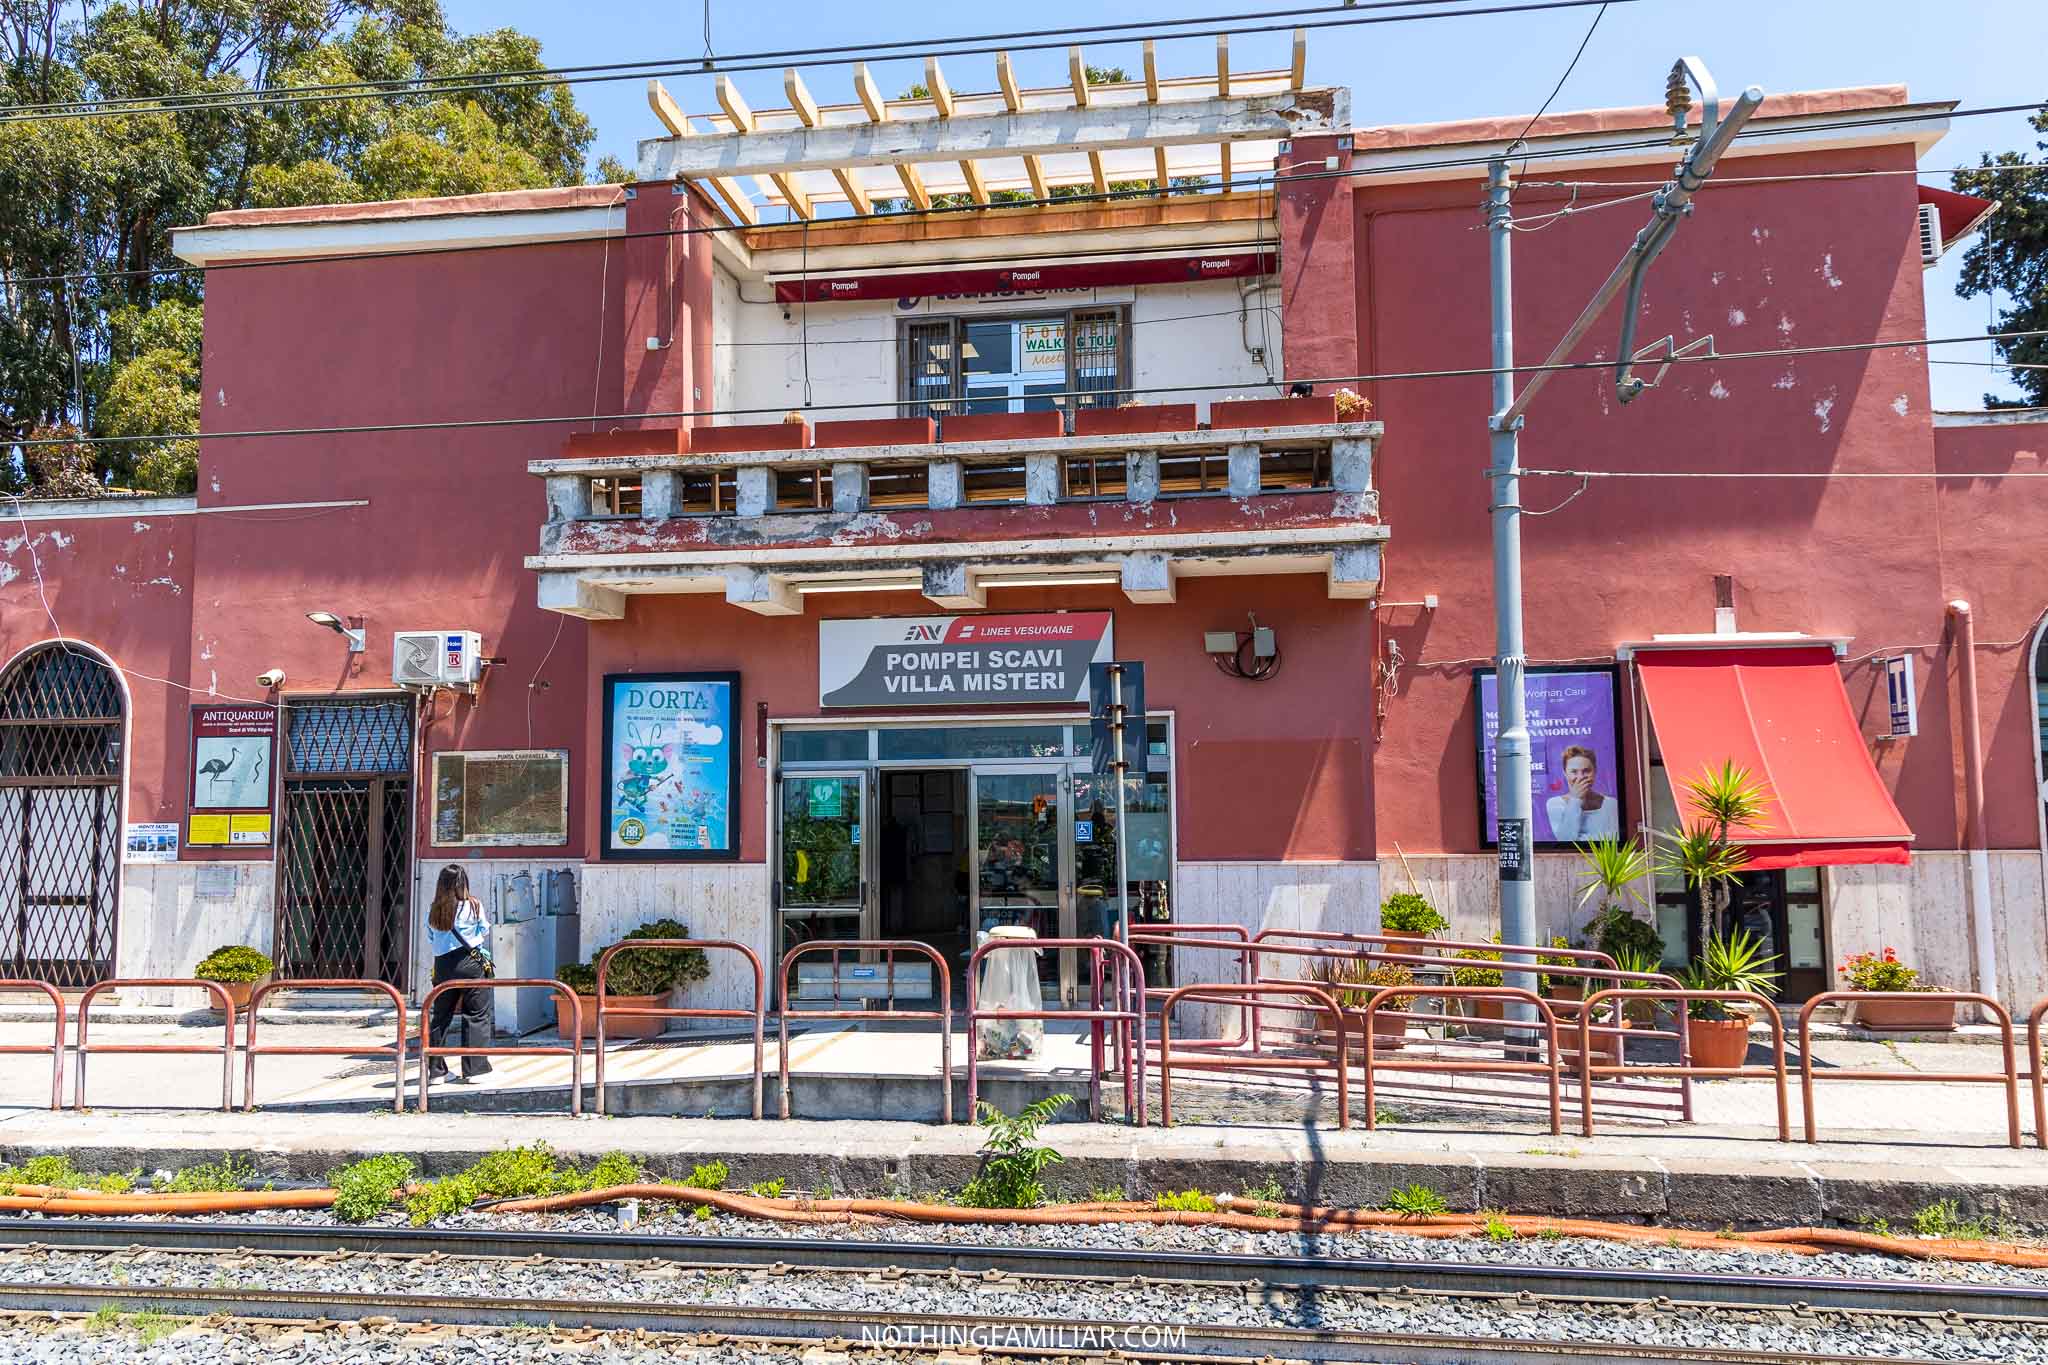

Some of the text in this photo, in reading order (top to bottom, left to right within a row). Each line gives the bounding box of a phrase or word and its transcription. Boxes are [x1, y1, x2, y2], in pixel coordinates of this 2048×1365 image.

[1201, 259, 1230, 270] Pompeii
[1012, 271, 1040, 281] Pompeii
[831, 281, 858, 291] Pompeii
[980, 625, 1073, 636] LINEE VESUVIANE
[887, 649, 1063, 671] POMPEI SCAVI
[883, 672, 1065, 693] VILLA MISTERI
[1564, 687, 1586, 697] Care
[202, 711, 274, 722] ANTIQUARIUM
